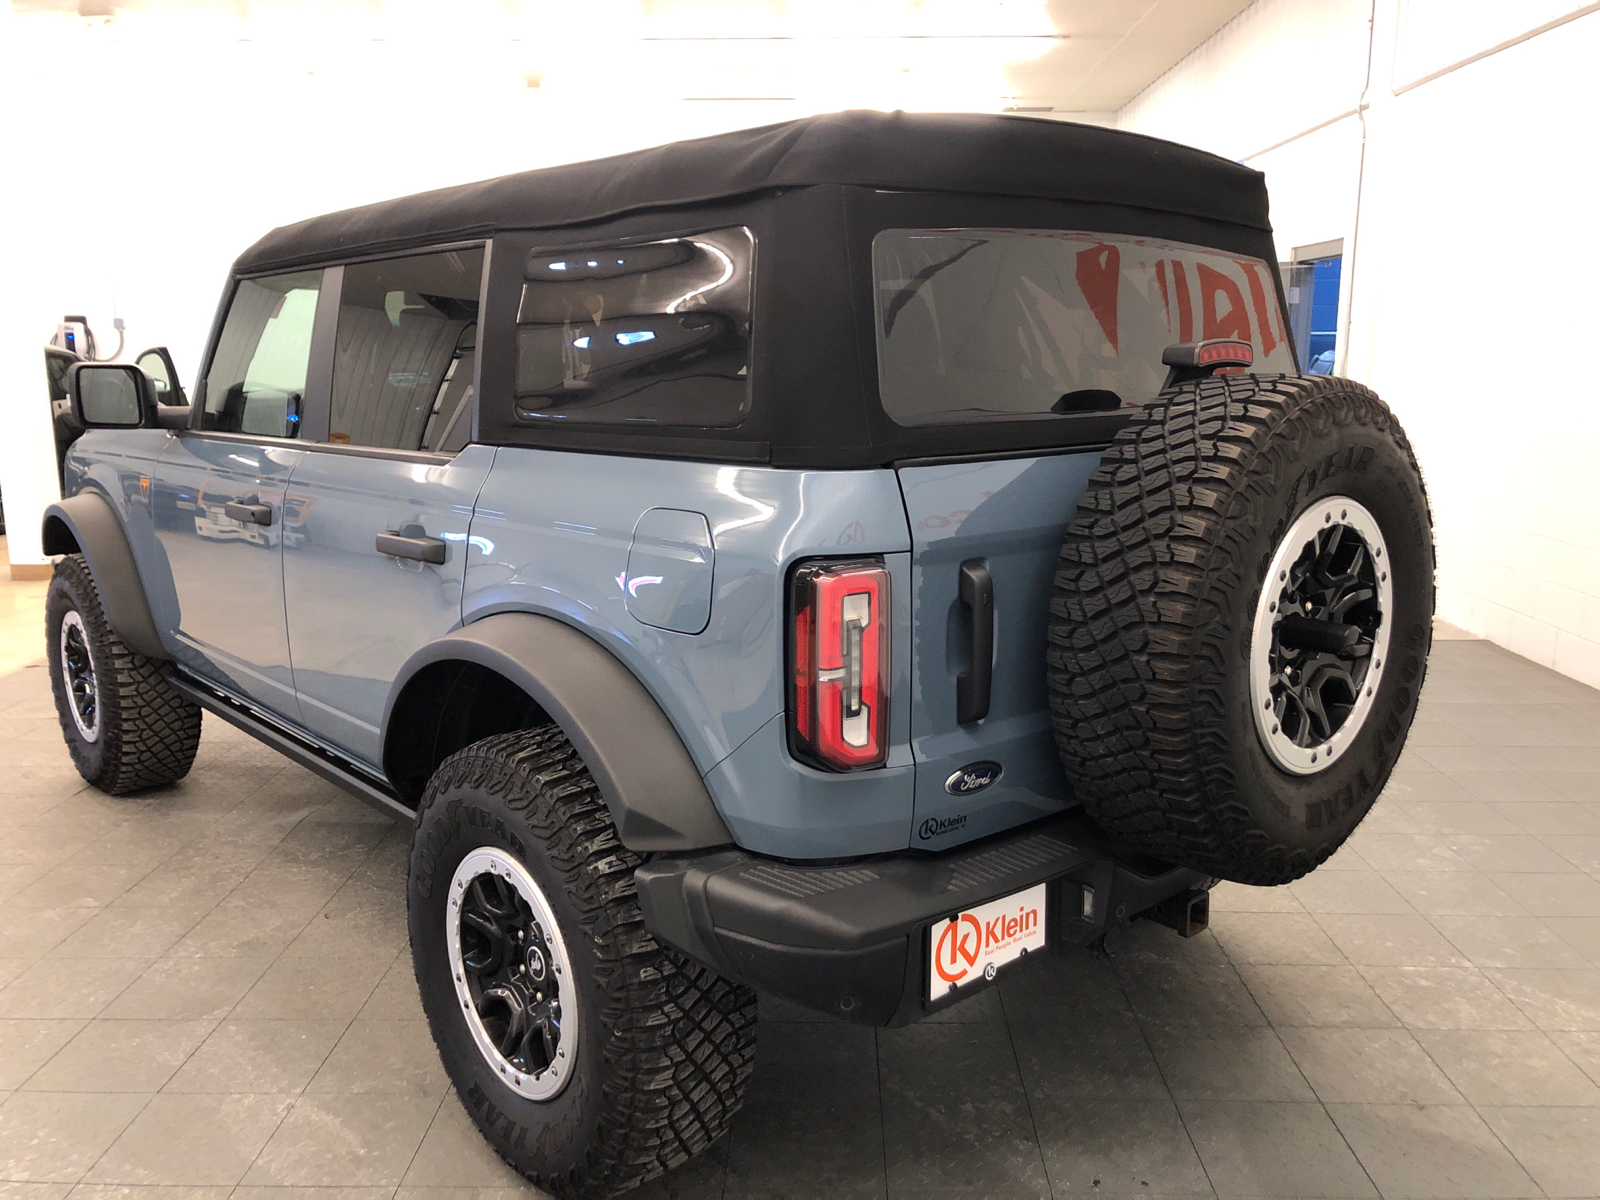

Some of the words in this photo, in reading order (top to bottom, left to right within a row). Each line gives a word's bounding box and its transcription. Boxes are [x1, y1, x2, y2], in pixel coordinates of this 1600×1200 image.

[960, 771, 991, 791] Ford
[939, 814, 967, 830] Klein
[415, 798, 526, 898] GOODYEAR
[985, 906, 1038, 949] Klein
[985, 947, 995, 956] Real
[1013, 933, 1023, 943] Real
